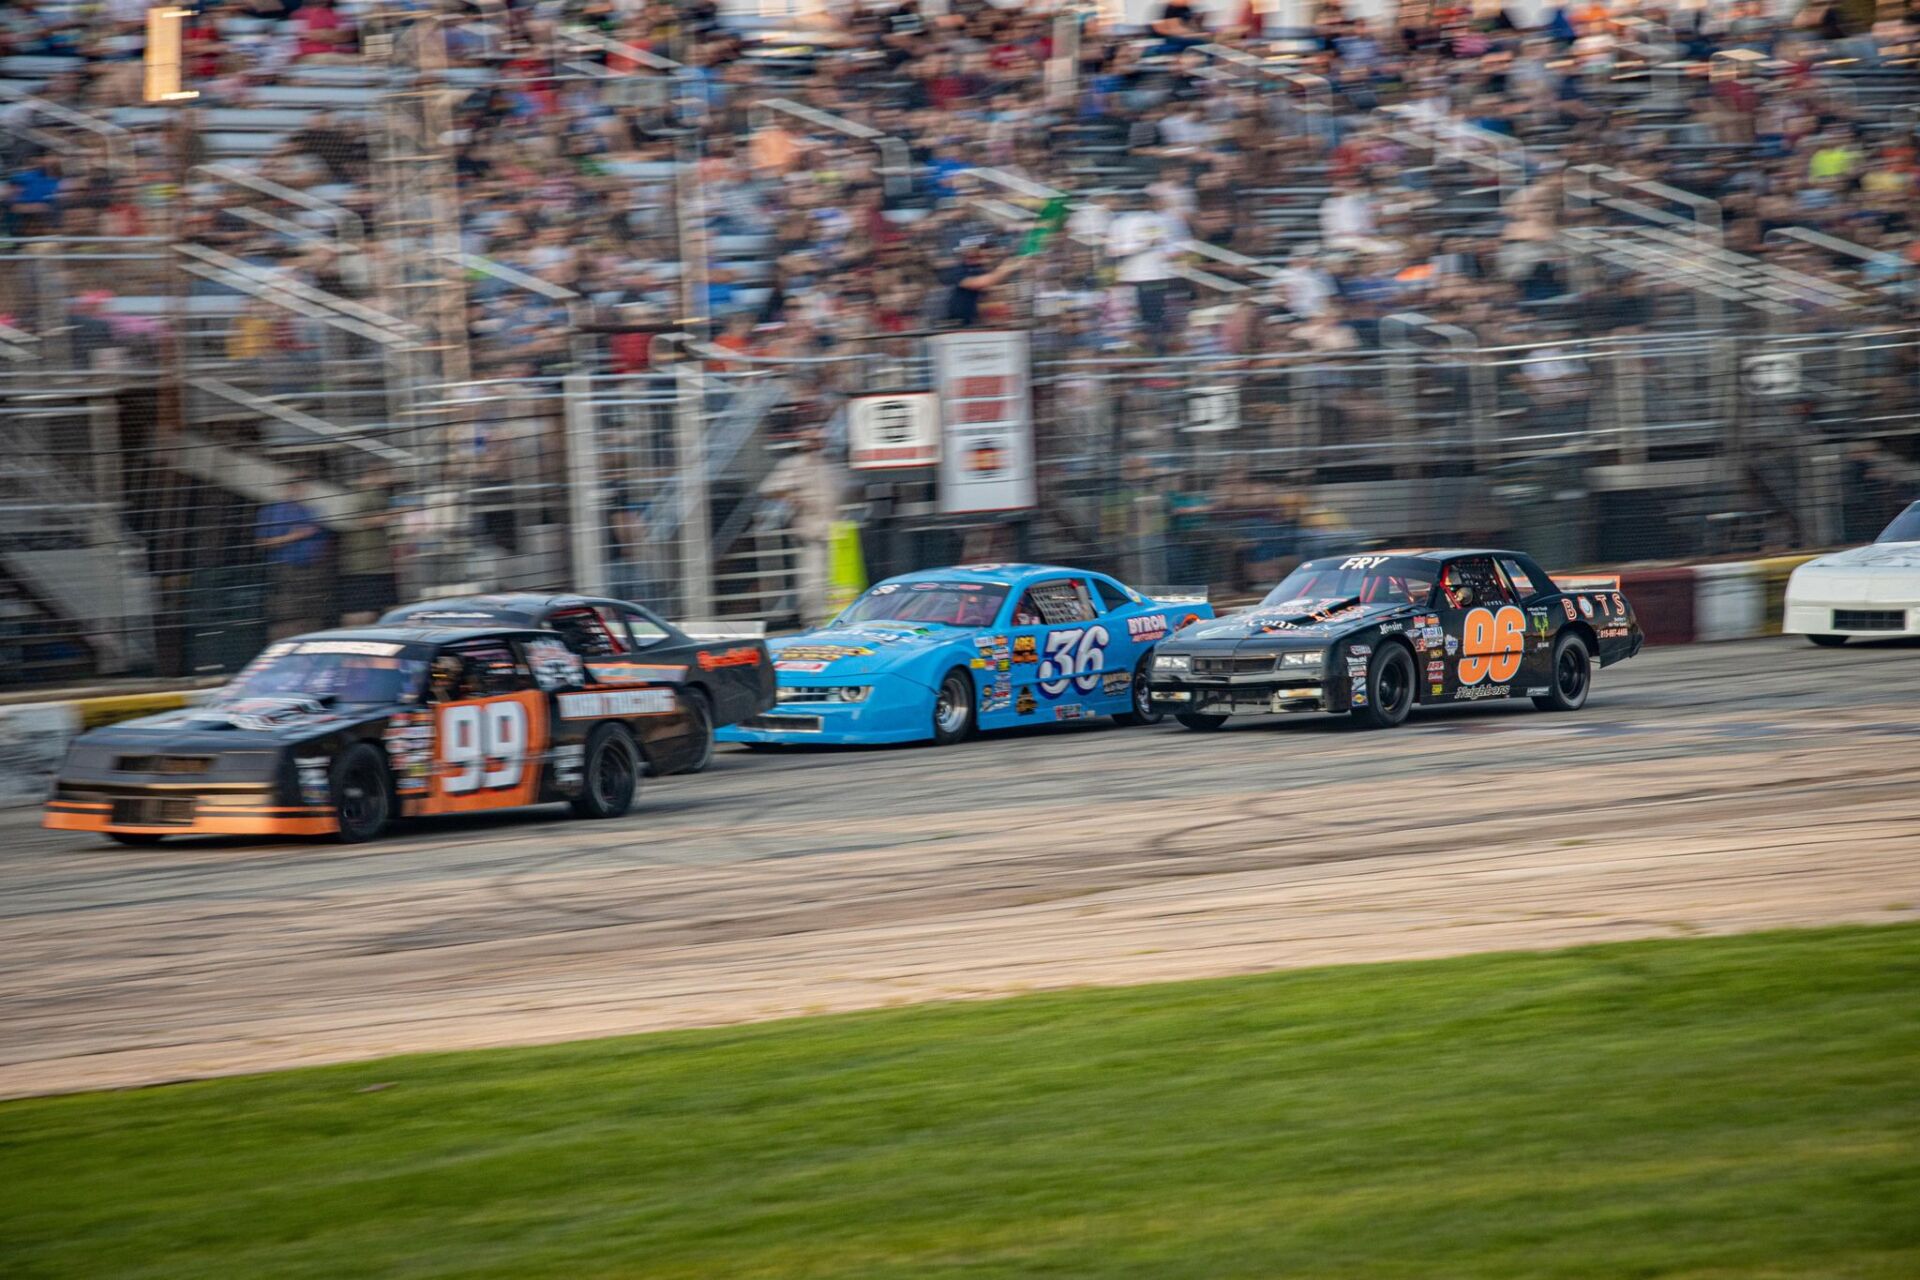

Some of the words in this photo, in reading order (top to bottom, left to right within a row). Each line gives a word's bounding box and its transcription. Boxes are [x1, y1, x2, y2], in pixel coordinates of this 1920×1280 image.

[1339, 556, 1390, 570] FRY
[1127, 614, 1167, 635] BYRON
[1457, 604, 1527, 686] 96
[1038, 625, 1110, 695] 36
[1454, 684, 1511, 700] Neighbors
[439, 700, 528, 793] 99
